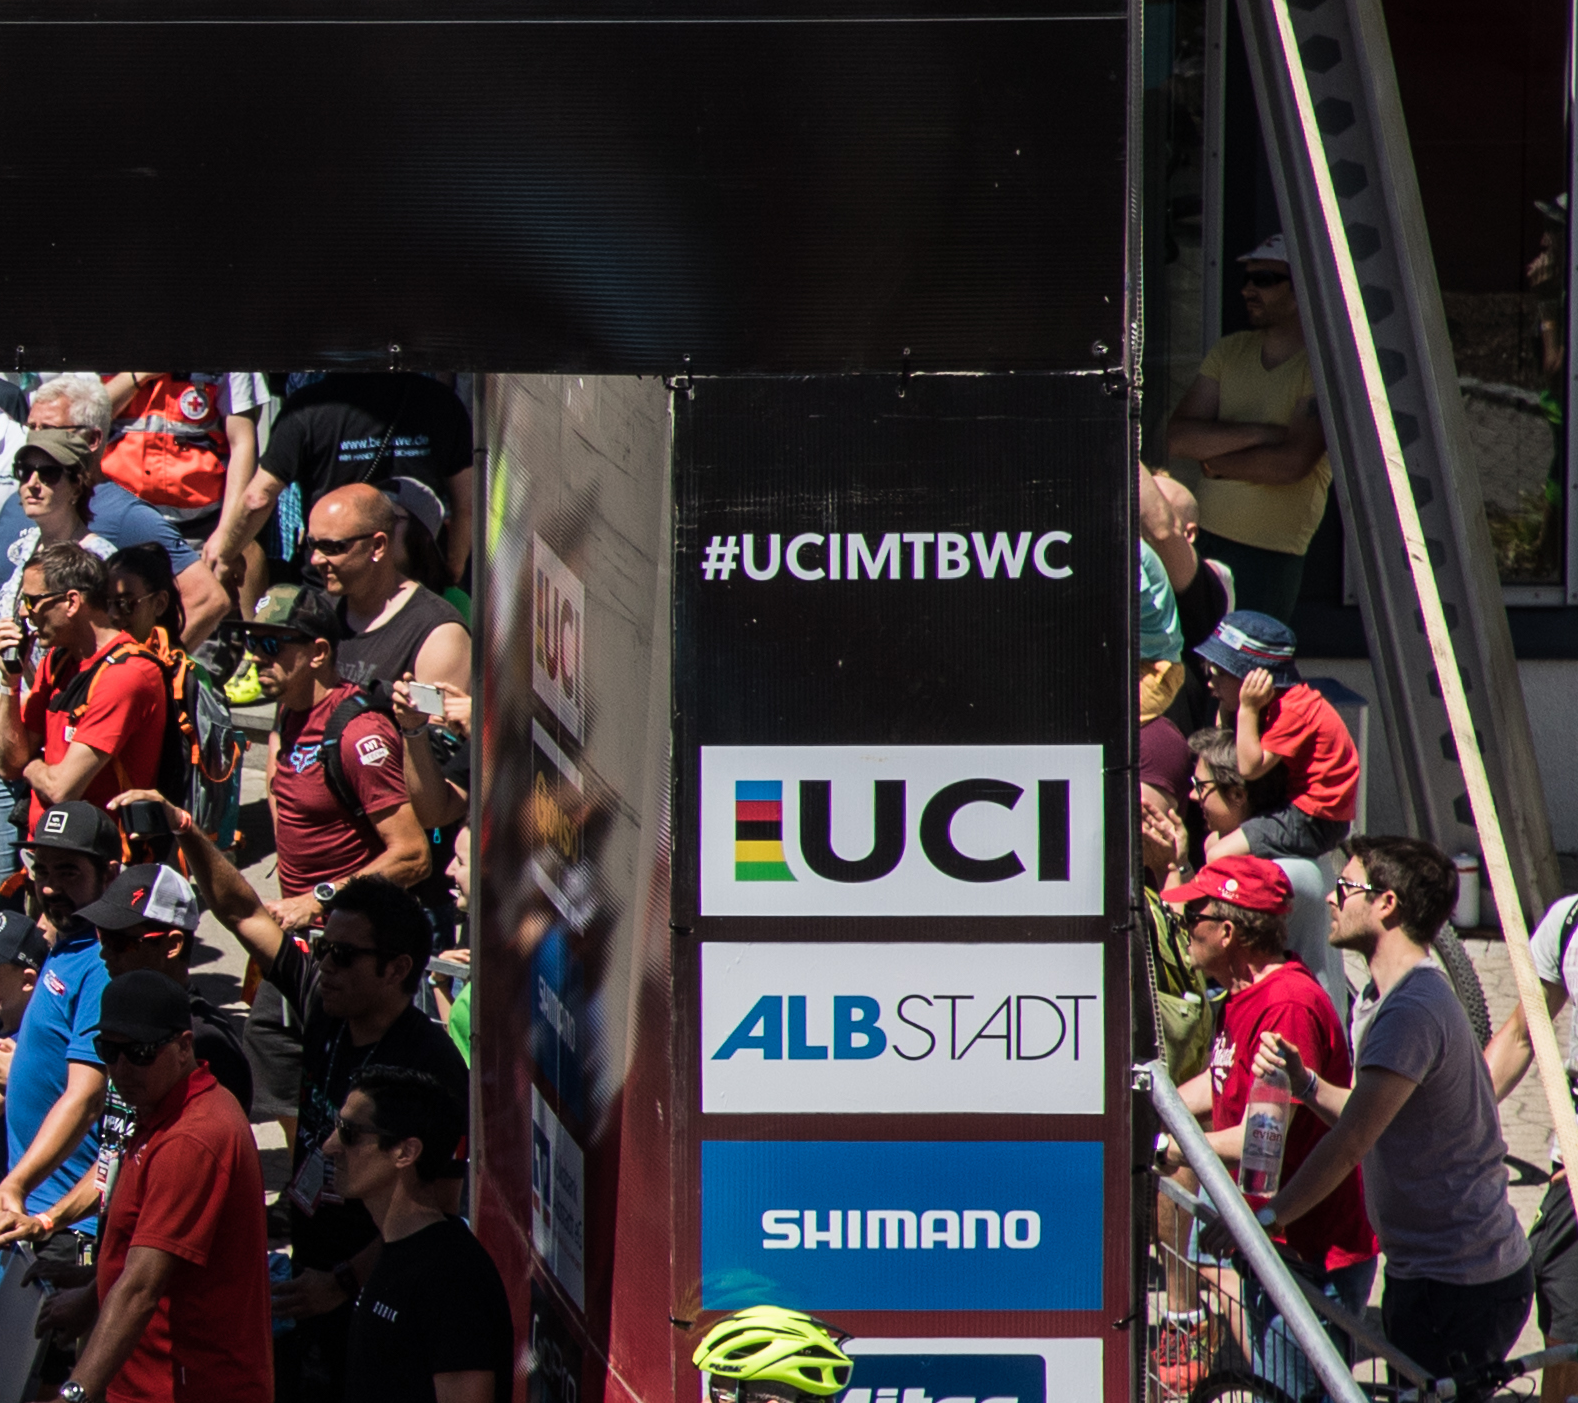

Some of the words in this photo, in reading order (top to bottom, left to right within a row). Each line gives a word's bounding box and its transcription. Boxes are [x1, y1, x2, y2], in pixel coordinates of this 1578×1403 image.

[701, 531, 1072, 582] #UCIMTBWC
[798, 778, 1070, 883] UCI
[711, 994, 1095, 1061] ALBSTADT
[762, 1209, 1041, 1250] SHIMANO
